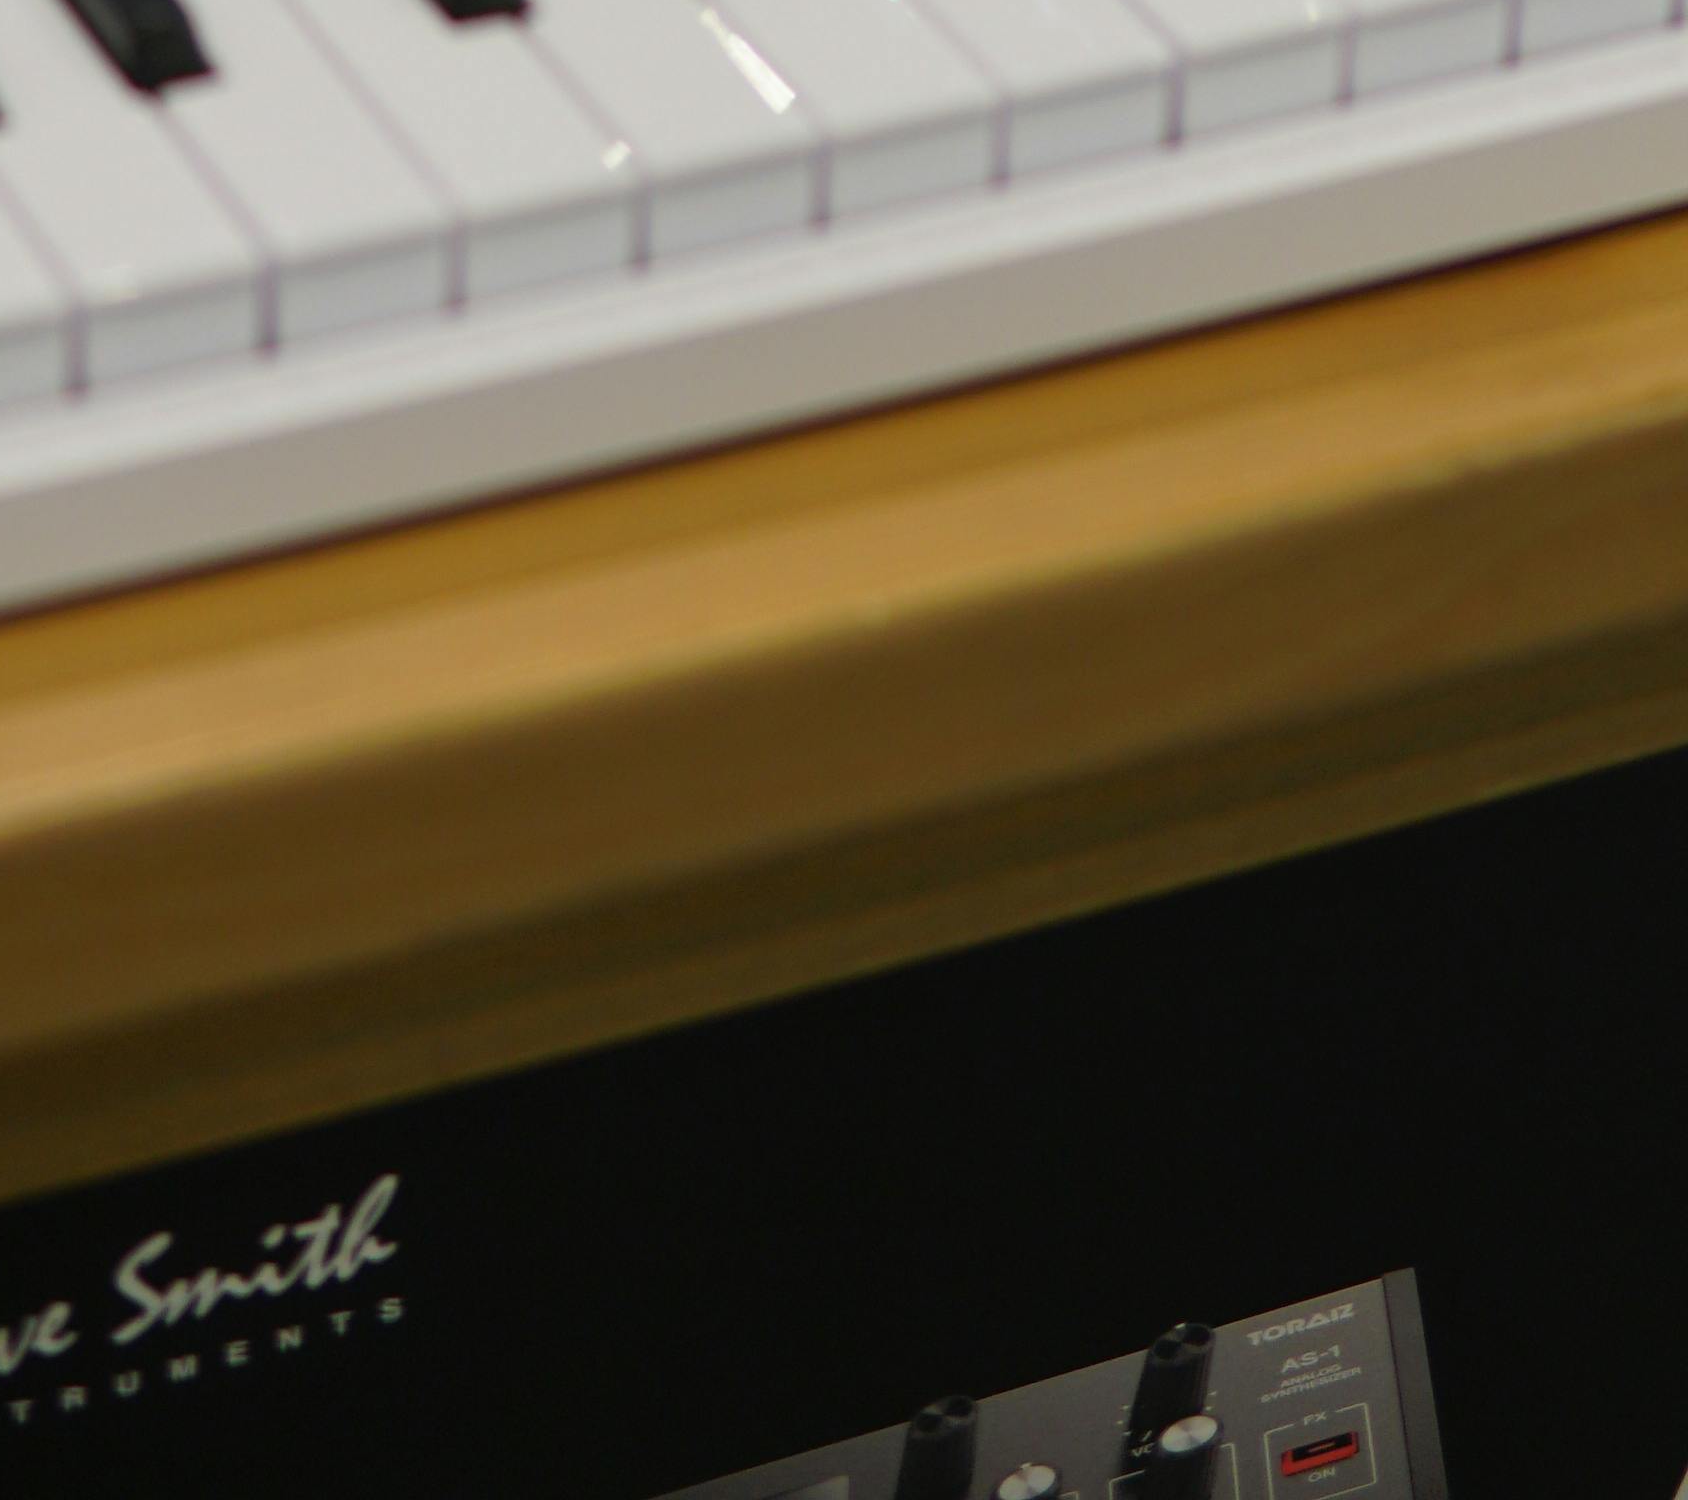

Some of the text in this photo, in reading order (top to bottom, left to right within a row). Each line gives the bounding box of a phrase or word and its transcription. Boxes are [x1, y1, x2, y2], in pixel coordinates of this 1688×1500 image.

[109, 1173, 401, 1345] Smith
[1246, 1302, 1356, 1348] TORAIZ
[1280, 1345, 1342, 1374] AS-1
[1303, 1411, 1328, 1427] FX
[1308, 1466, 1336, 1484] ON
